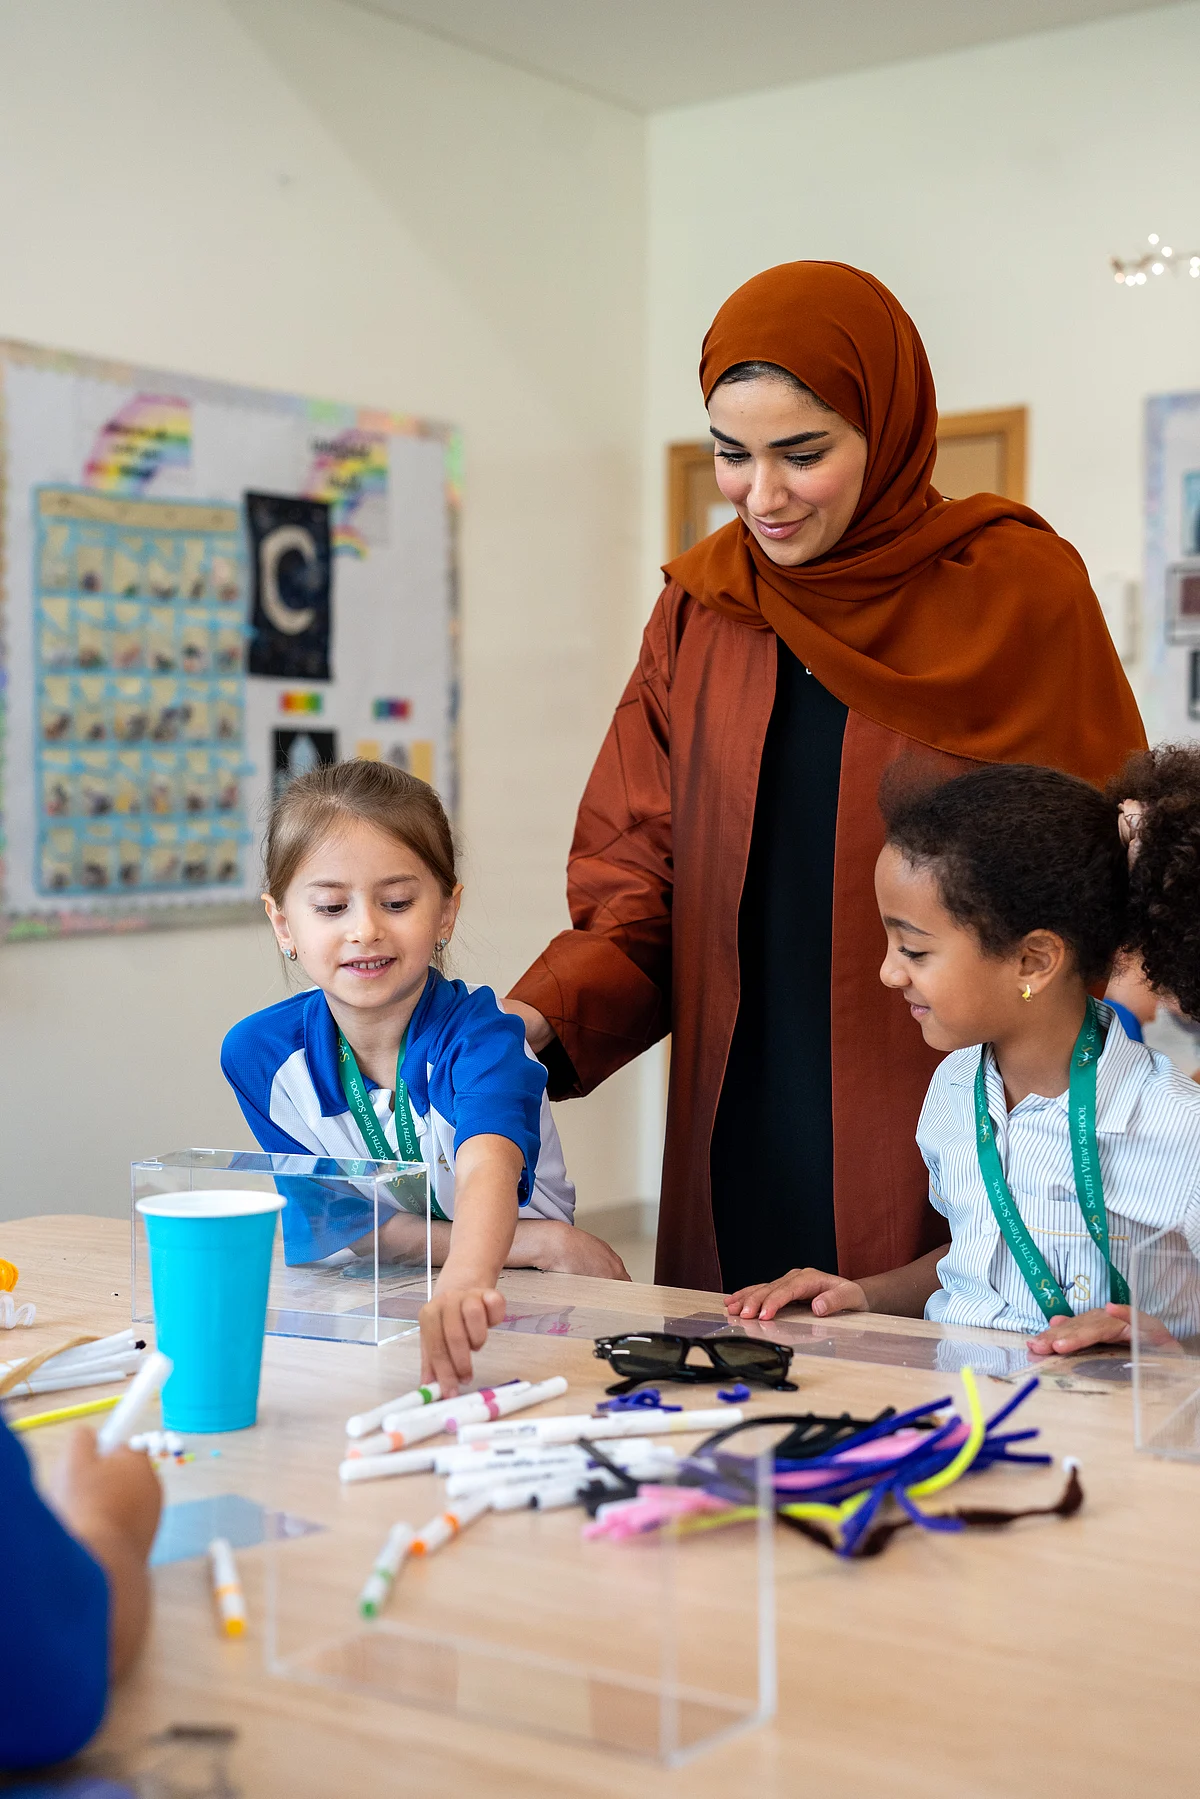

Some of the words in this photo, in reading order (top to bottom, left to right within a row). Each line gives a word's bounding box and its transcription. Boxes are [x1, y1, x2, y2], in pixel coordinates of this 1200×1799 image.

[349, 1077, 367, 1113] SCHOOL
[362, 1113, 375, 1136] VIEW
[400, 1103, 408, 1127] VIEW
[1078, 1104, 1088, 1145] SCHOOL
[403, 1127, 415, 1155] SOUTH
[1081, 1147, 1091, 1173] VIEW
[992, 1178, 1012, 1218] SCHOOL
[1084, 1174, 1096, 1209] SOUTH
[1007, 1217, 1023, 1244] VIEW
[1019, 1242, 1041, 1276] SOUTH
